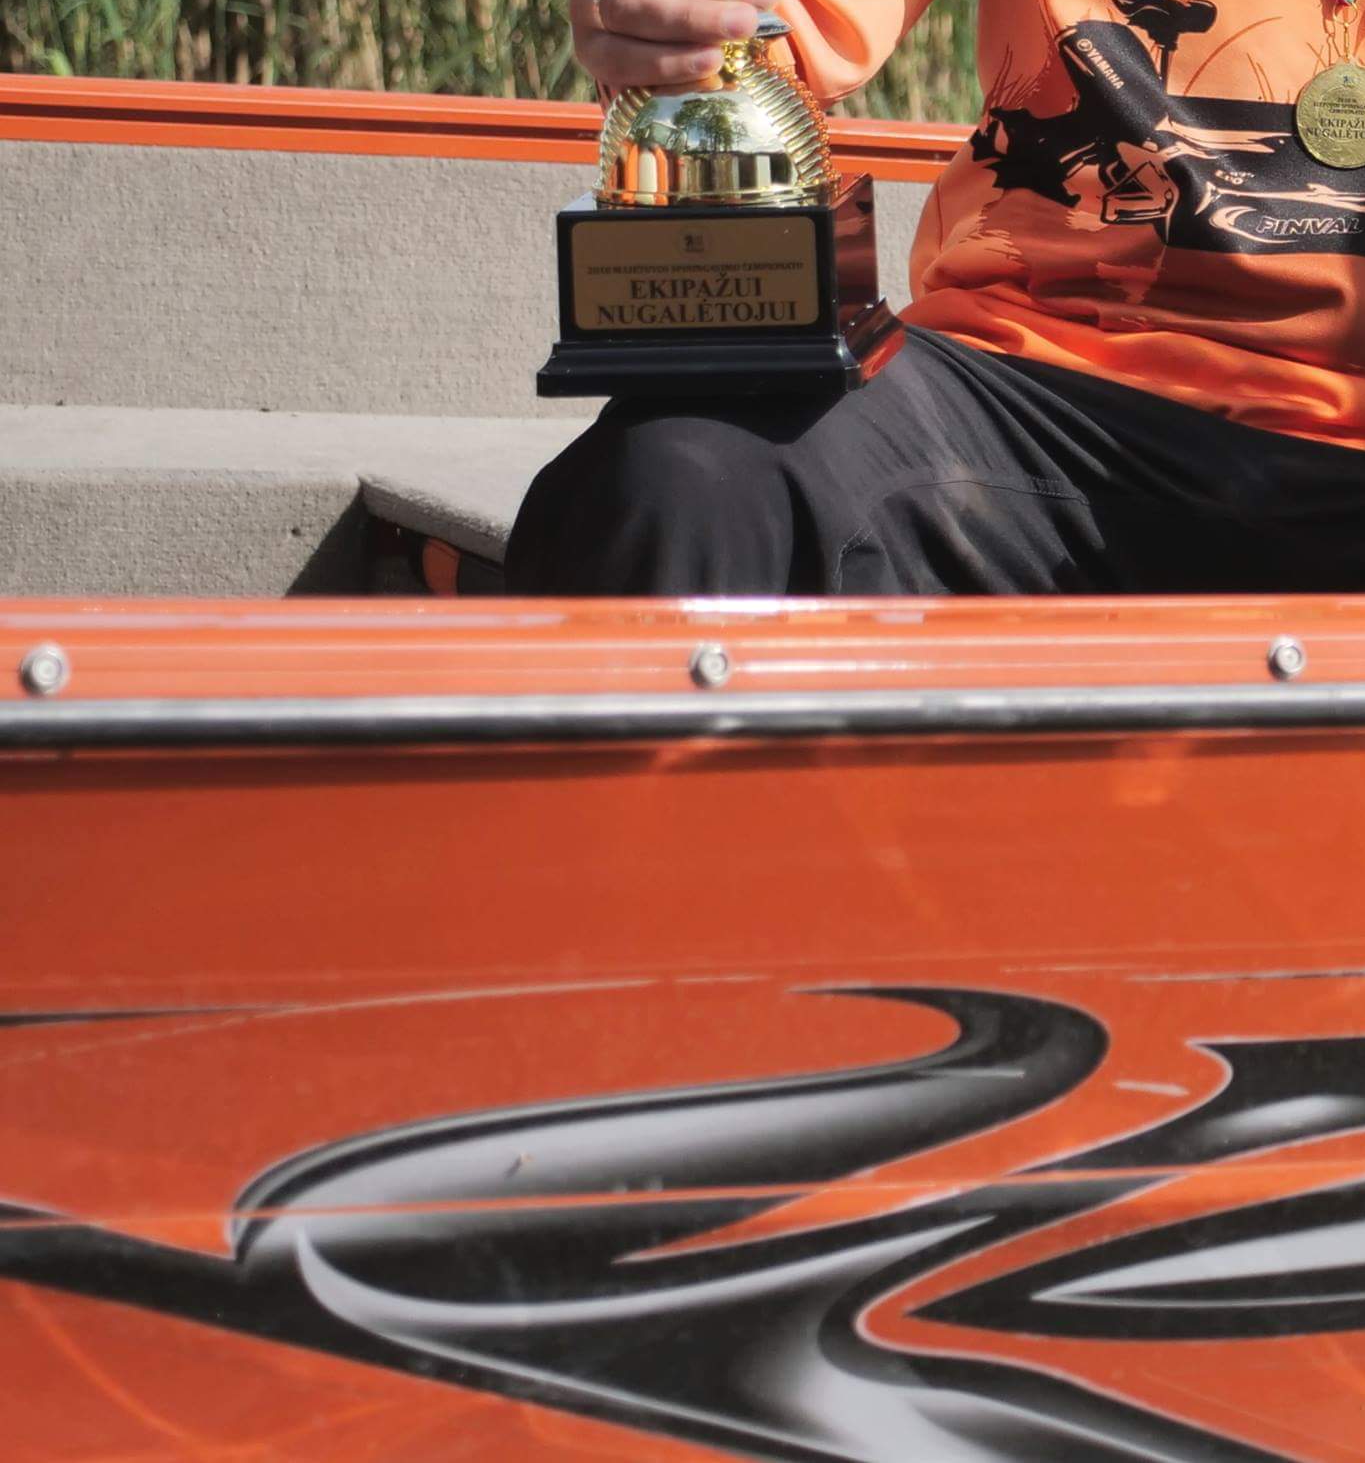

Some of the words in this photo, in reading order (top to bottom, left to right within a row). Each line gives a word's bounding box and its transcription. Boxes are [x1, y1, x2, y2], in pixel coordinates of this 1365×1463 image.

[1256, 215, 1363, 236] FINVAL
[629, 273, 763, 300] EKIPAŽUI
[596, 298, 797, 325] NUGALĖTOJUI
